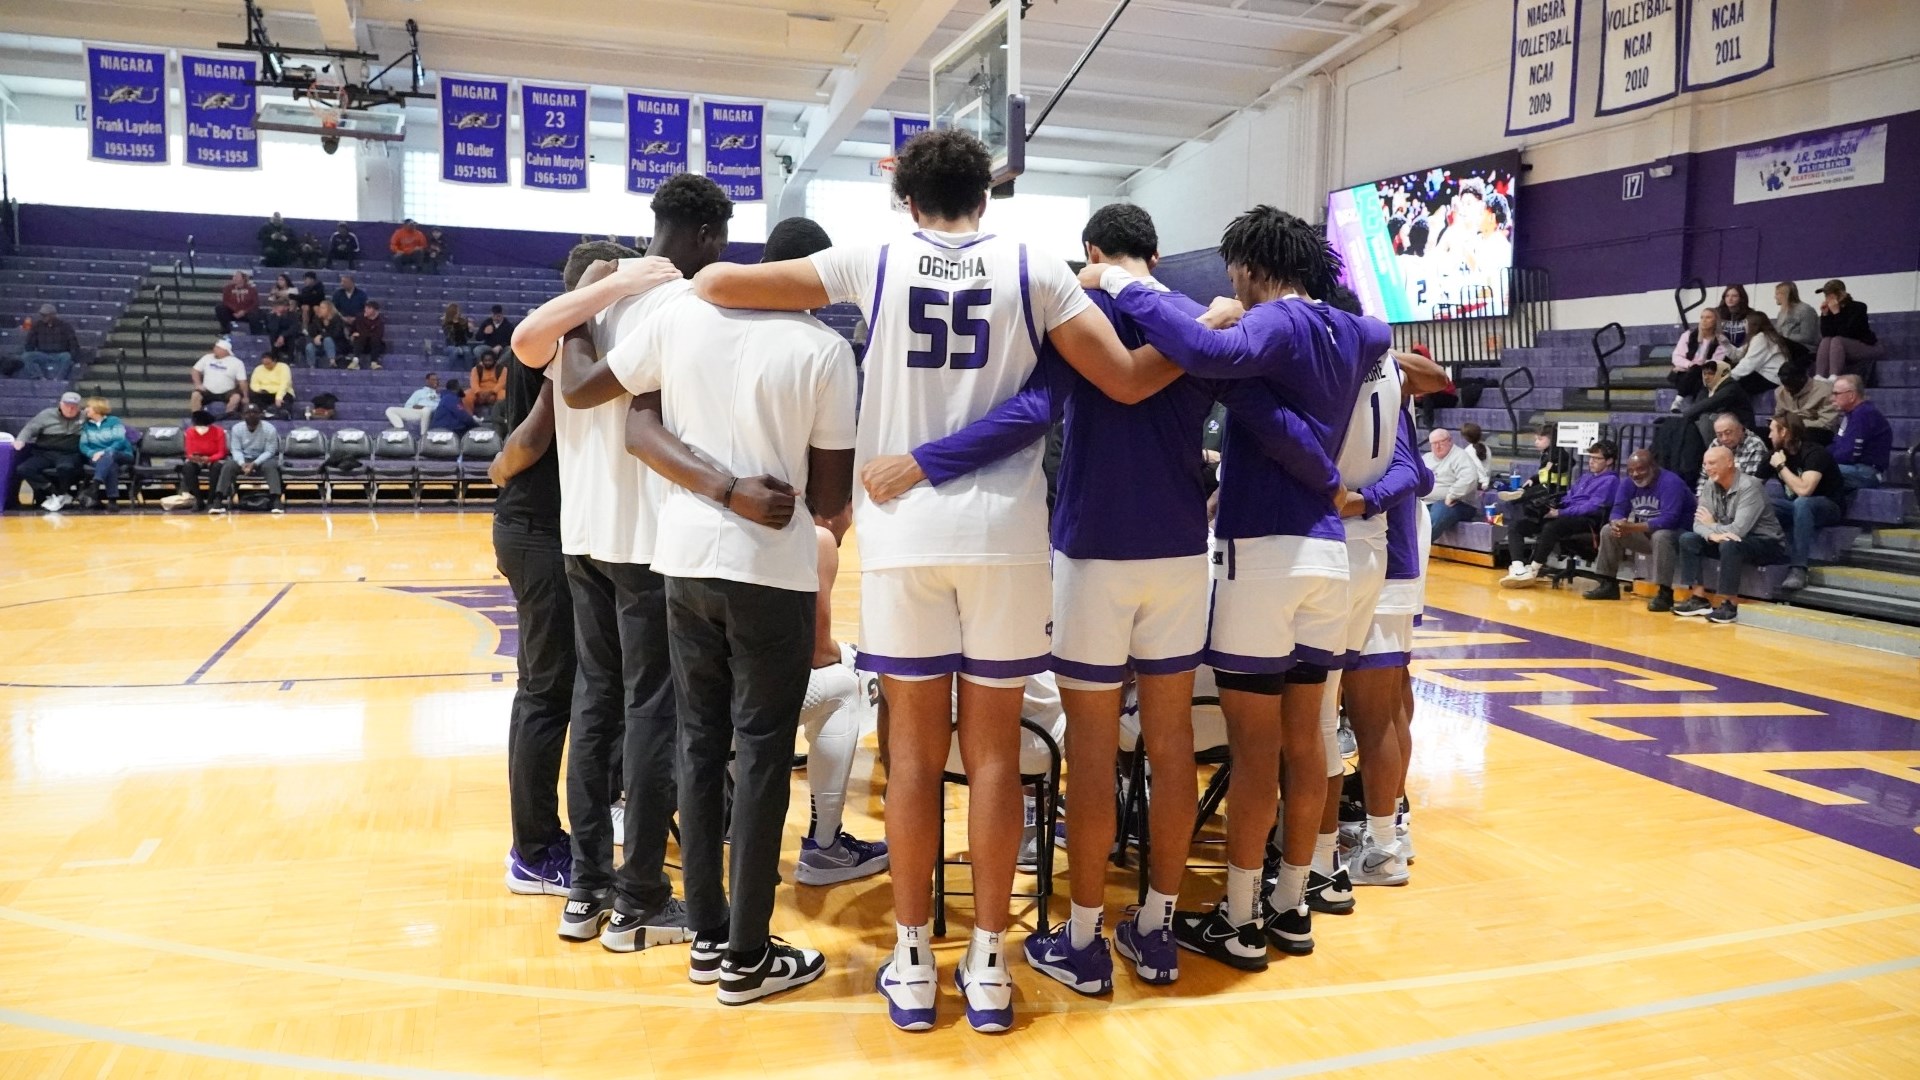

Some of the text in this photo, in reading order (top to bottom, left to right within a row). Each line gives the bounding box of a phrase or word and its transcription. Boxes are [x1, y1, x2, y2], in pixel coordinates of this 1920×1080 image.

[1527, 0, 1566, 27] NIAGARA
[1712, 1, 1744, 31] NCAA
[1624, 31, 1652, 60] NCAA
[1715, 36, 1742, 65] 2011
[100, 54, 153, 73] NIAGARA
[194, 62, 246, 80] NIAGARA
[1529, 61, 1554, 86] NCAA
[1625, 66, 1649, 92] 2010
[451, 84, 497, 100] NIAGARA
[532, 91, 577, 107] NIAGARA
[637, 99, 680, 116] NIAGARA
[1529, 92, 1552, 115] 2009
[545, 111, 565, 128] 23
[712, 107, 754, 122] NIAGARA
[96, 117, 162, 137] Frank Layden
[653, 118, 663, 135] 3
[105, 142, 155, 157] 1951-1955
[198, 147, 248, 162] 1954-1958
[456, 142, 494, 158] Al Butler
[1812, 140, 1859, 160] SWANSON
[526, 151, 586, 170] Calvin Murphy
[631, 158, 686, 175] Phil Scaffidi
[706, 160, 761, 178] Eva Cunningham
[454, 164, 497, 178] 1957-1961
[534, 171, 578, 185] 1966-1970
[1626, 174, 1641, 198] 17
[918, 255, 986, 281] OBIOHA
[907, 286, 992, 369] 55
[1370, 391, 1381, 459] 1
[565, 900, 590, 914] NIKE
[696, 941, 711, 949] NIKE
